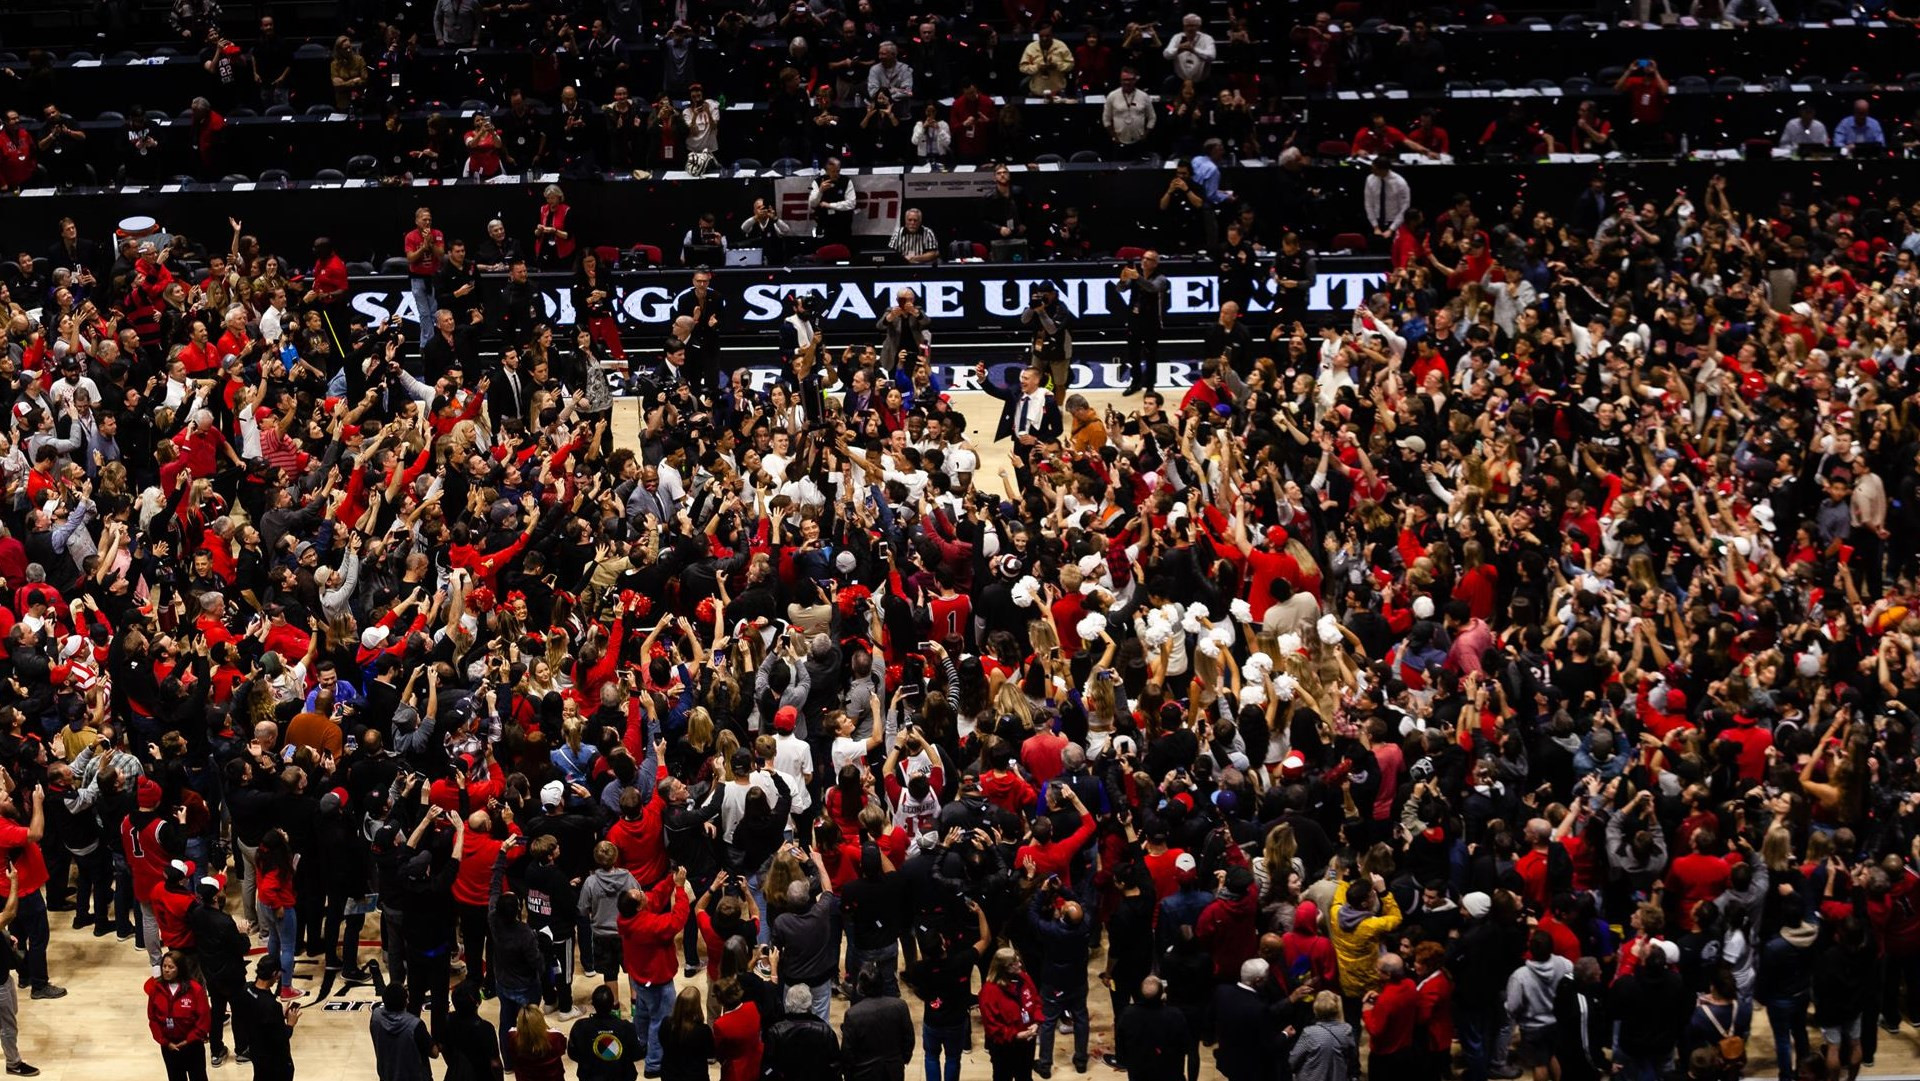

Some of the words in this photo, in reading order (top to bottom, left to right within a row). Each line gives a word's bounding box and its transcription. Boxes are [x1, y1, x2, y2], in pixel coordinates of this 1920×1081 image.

[782, 191, 898, 220] EN
[743, 281, 962, 321] STATE
[978, 273, 1385, 319] UNIEIT
[946, 610, 957, 635] 1
[902, 800, 936, 814] LEONARD
[129, 825, 145, 858] 1
